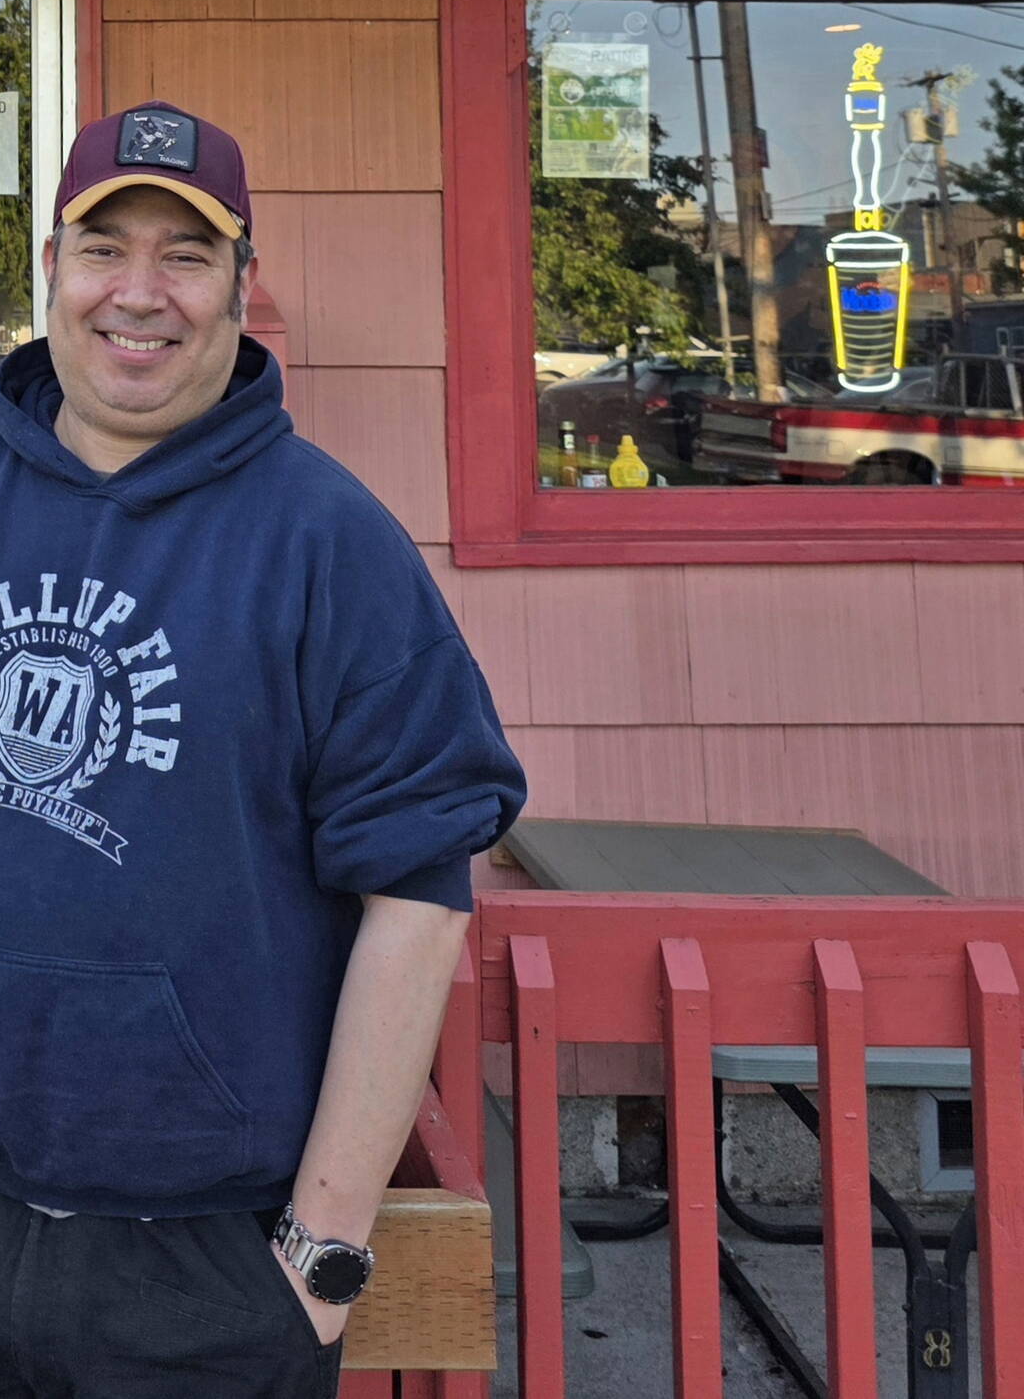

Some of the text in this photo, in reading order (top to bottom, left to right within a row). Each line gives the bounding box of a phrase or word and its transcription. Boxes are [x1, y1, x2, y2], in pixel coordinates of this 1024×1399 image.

[88, 643, 119, 678] 1900
[116, 627, 181, 772] FAIR
[12, 668, 82, 746] WA
